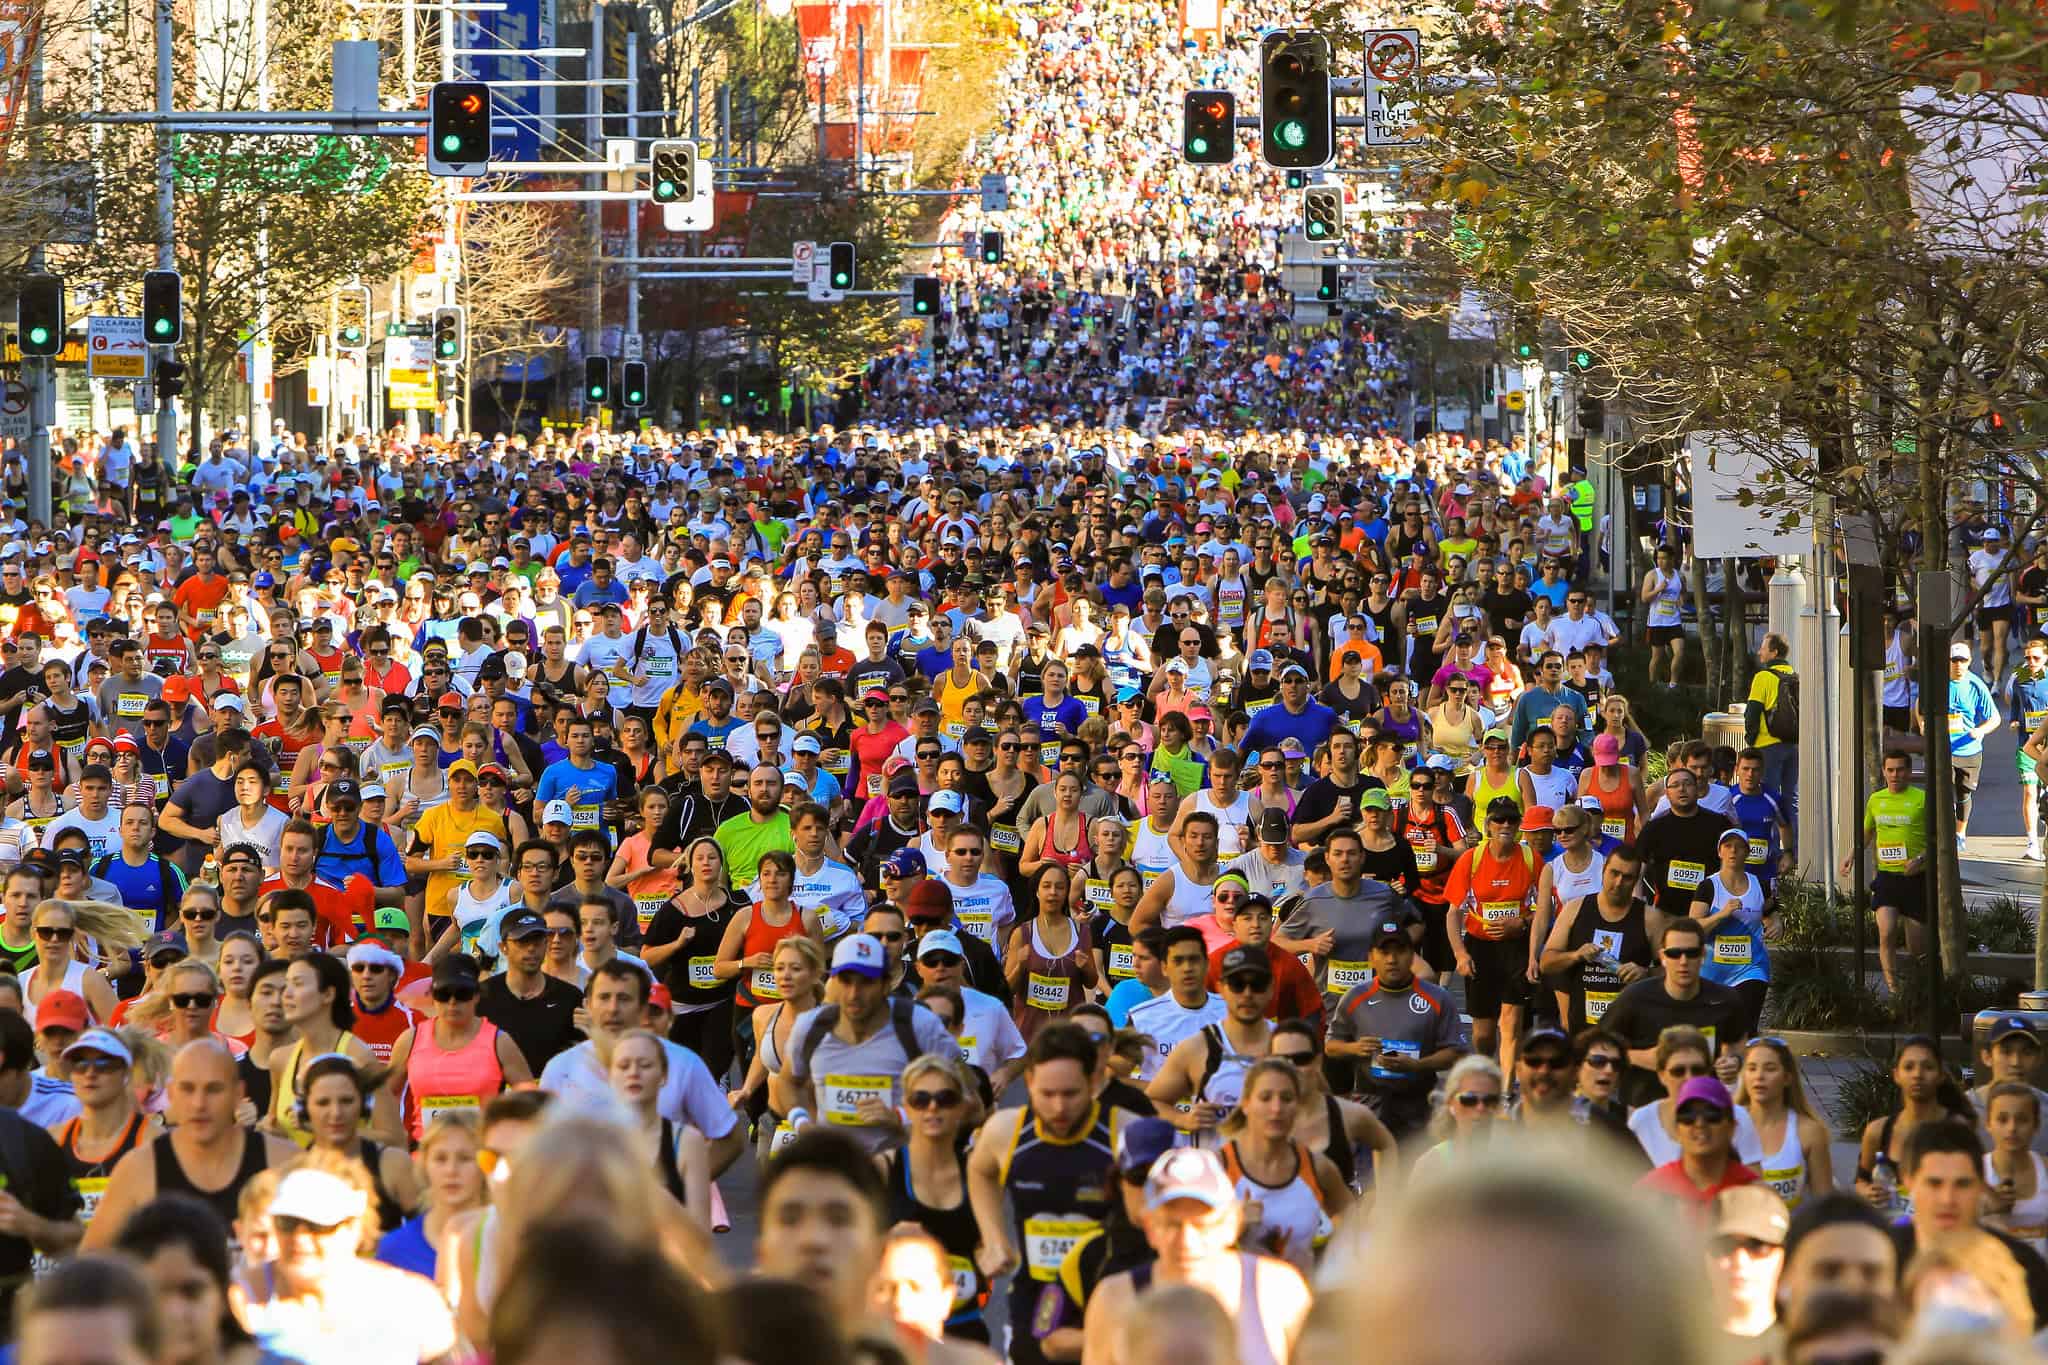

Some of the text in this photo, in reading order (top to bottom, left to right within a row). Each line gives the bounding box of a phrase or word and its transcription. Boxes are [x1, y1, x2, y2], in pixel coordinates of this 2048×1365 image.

[95, 319, 142, 327] CLEARWAY
[1416, 853, 1432, 862] 923
[1673, 867, 1699, 880] 60957
[1719, 942, 1747, 954] 65700
[1334, 969, 1366, 982] 63204
[1033, 985, 1063, 997] 68442
